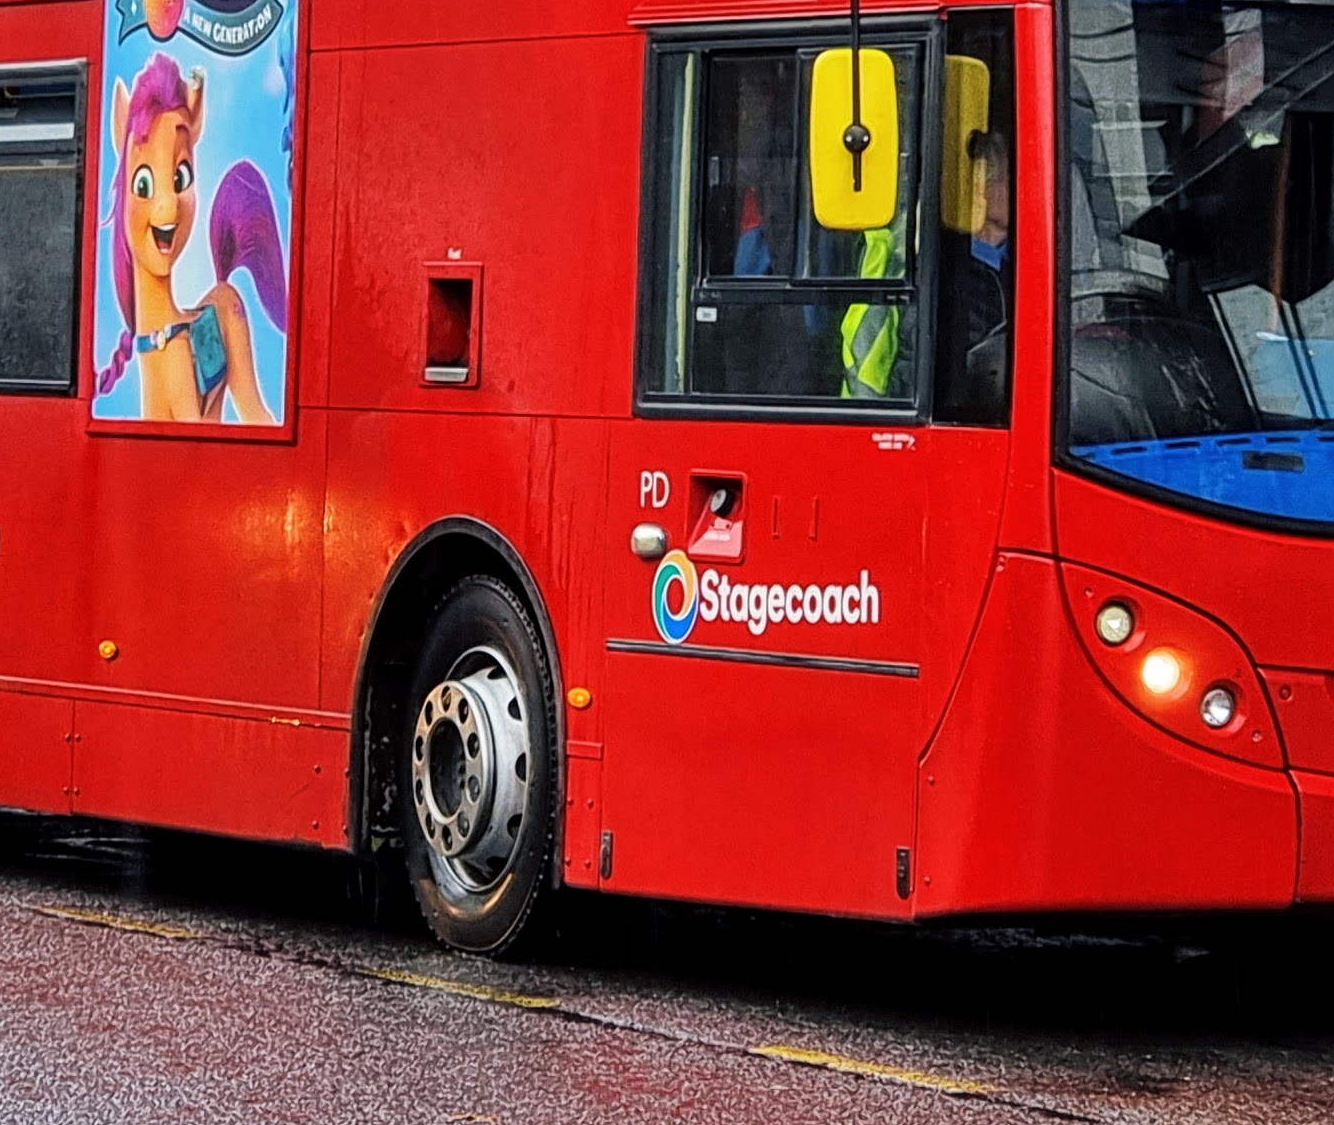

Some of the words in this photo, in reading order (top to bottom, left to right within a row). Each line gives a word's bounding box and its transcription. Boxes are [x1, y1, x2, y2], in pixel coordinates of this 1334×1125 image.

[182, 6, 191, 24] A
[192, 12, 213, 37] NEW
[640, 470, 670, 508] PD
[699, 568, 880, 636] Stagecoach
